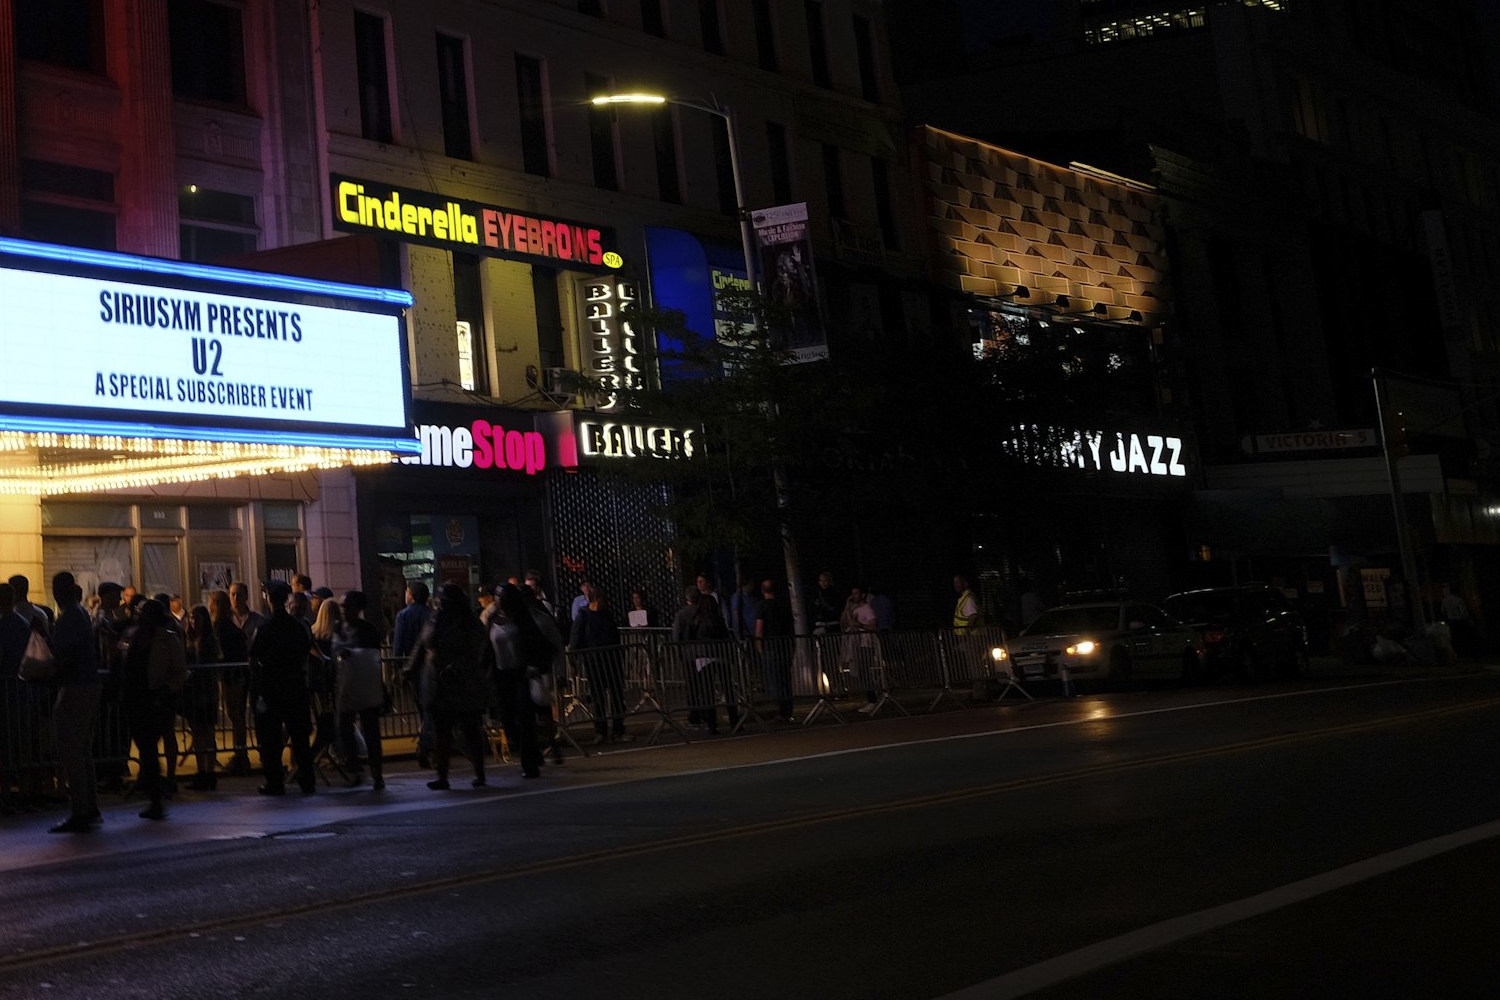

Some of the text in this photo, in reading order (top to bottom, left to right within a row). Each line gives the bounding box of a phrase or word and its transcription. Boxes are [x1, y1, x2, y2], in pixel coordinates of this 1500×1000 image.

[338, 181, 621, 267] Cinderella EYEBROWS SPA
[100, 290, 303, 342] SIRIUSXM PRESENTS
[191, 337, 224, 377] U2
[95, 372, 313, 411] A SPECIAL SUBSCRIBER EVENT
[405, 419, 546, 475] meStop
[1109, 432, 1186, 476] JAZZ
